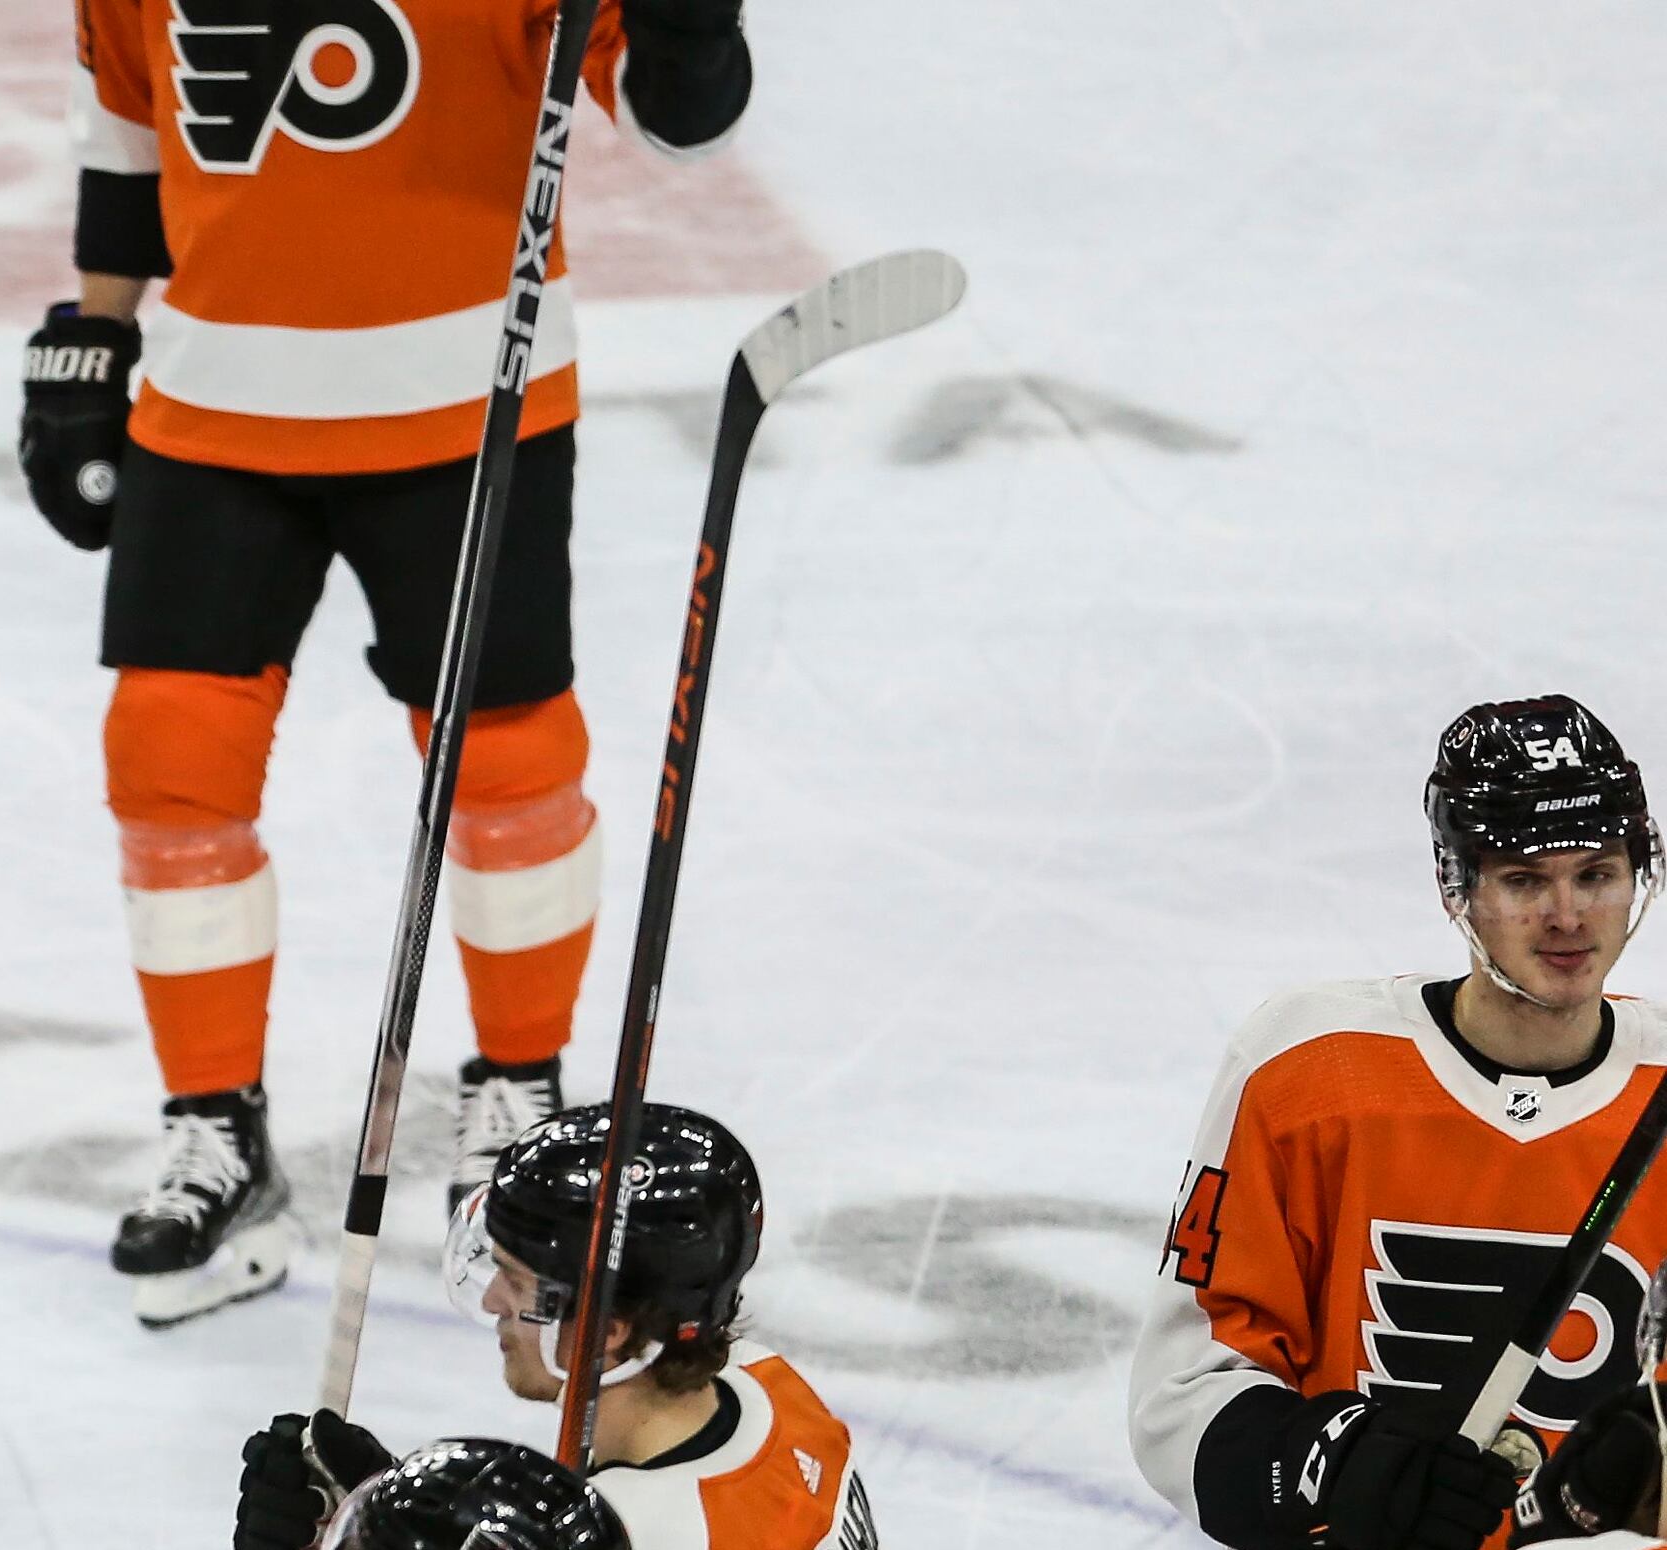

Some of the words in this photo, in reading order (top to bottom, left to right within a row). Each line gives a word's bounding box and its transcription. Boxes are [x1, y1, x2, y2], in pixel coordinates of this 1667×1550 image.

[491, 98, 573, 396] NEXUS
[26, 345, 114, 382] RIOR
[1524, 737, 1583, 771] 54
[1534, 794, 1601, 812] BAUER
[1158, 1160, 1229, 1289] 4
[1296, 1403, 1367, 1506] CC
[1271, 1461, 1282, 1505] FLYERS
